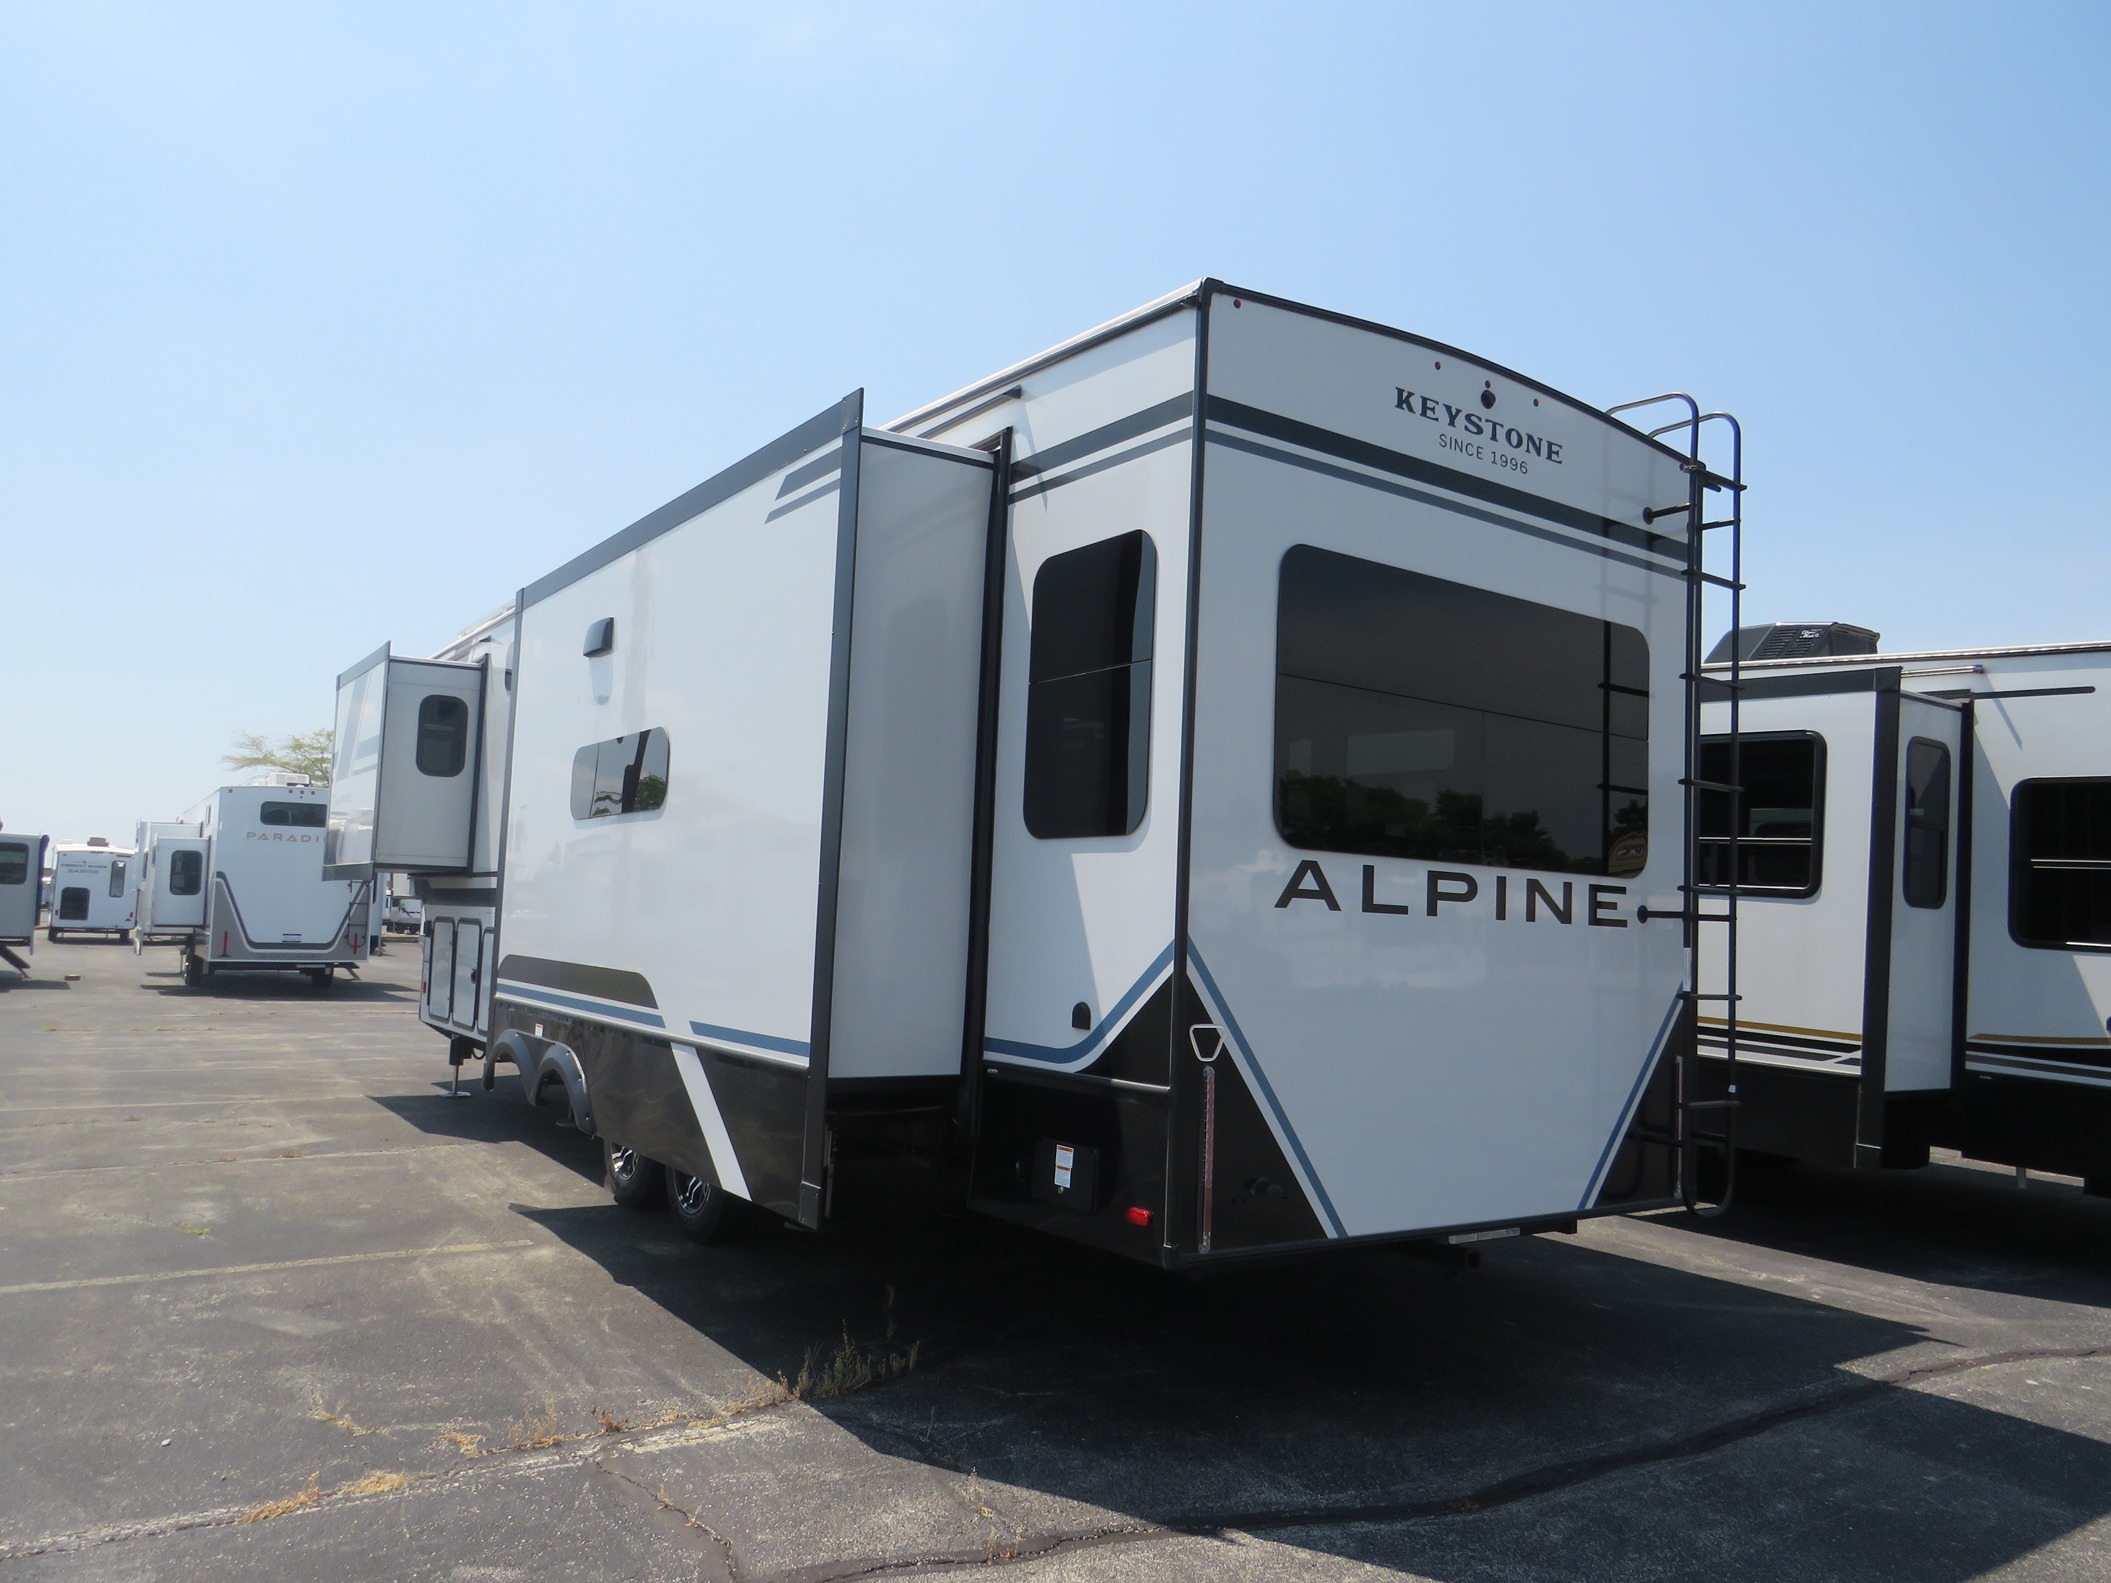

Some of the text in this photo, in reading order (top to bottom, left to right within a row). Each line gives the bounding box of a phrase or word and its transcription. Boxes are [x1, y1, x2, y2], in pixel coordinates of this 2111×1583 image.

[1394, 386, 1563, 465] KEYSTONE
[1438, 433, 1529, 475] SINCE 1996
[1274, 859, 1628, 928] ALPINE
